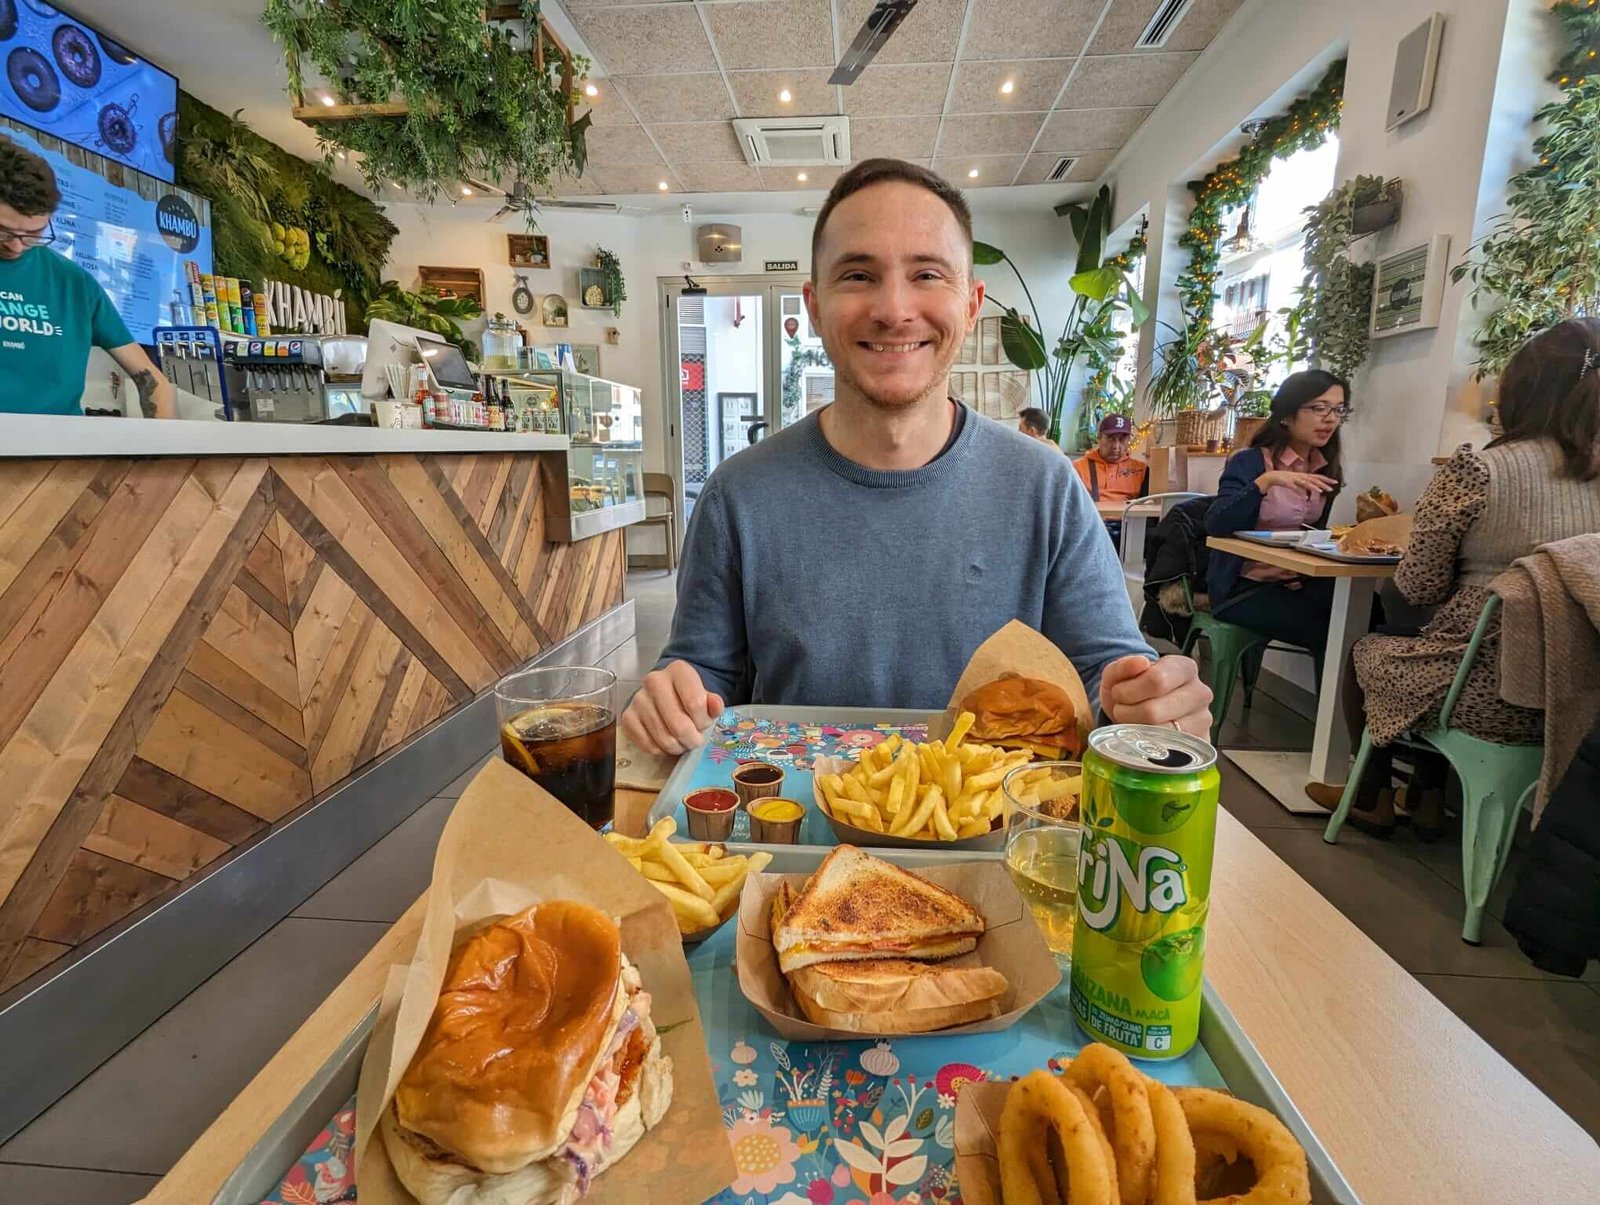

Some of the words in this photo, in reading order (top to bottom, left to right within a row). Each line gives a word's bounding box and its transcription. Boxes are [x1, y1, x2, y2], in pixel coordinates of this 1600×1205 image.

[159, 211, 197, 238] KHAMBÚ
[0, 291, 24, 302] CAN
[0, 315, 54, 336] ORLD
[1116, 417, 1124, 427] B
[1091, 1015, 1103, 1031] DE
[1098, 1011, 1142, 1034] ZUMO/SUMO
[1154, 1037, 1163, 1049] C
